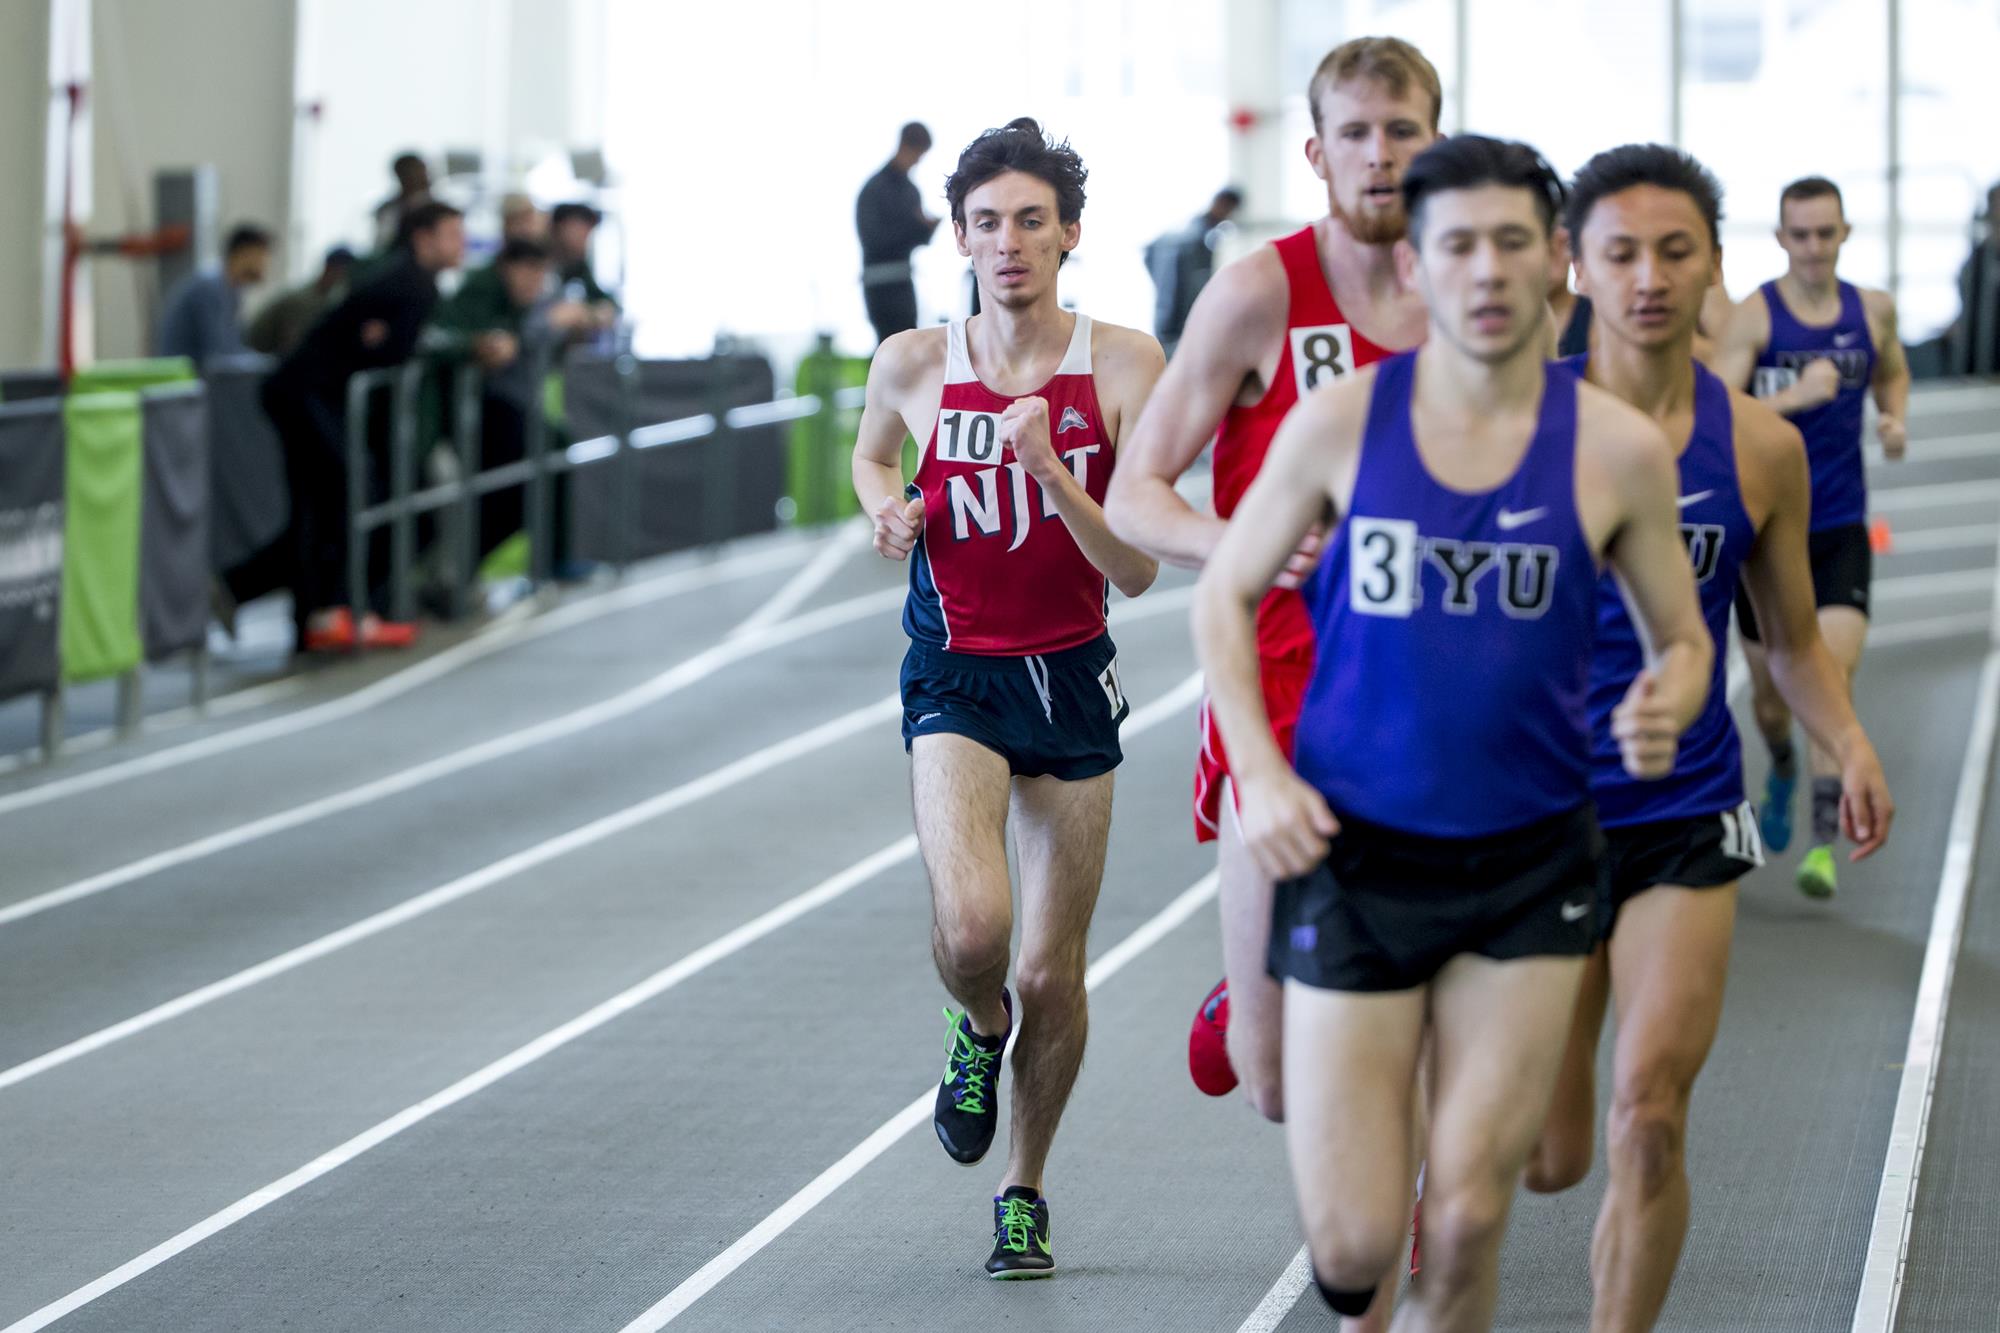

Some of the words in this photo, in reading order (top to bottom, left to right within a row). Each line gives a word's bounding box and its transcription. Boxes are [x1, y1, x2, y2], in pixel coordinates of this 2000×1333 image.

[1304, 333, 1344, 390] 8
[943, 412, 995, 461] 10
[1361, 530, 1396, 603] 3
[1419, 535, 1560, 620] YU
